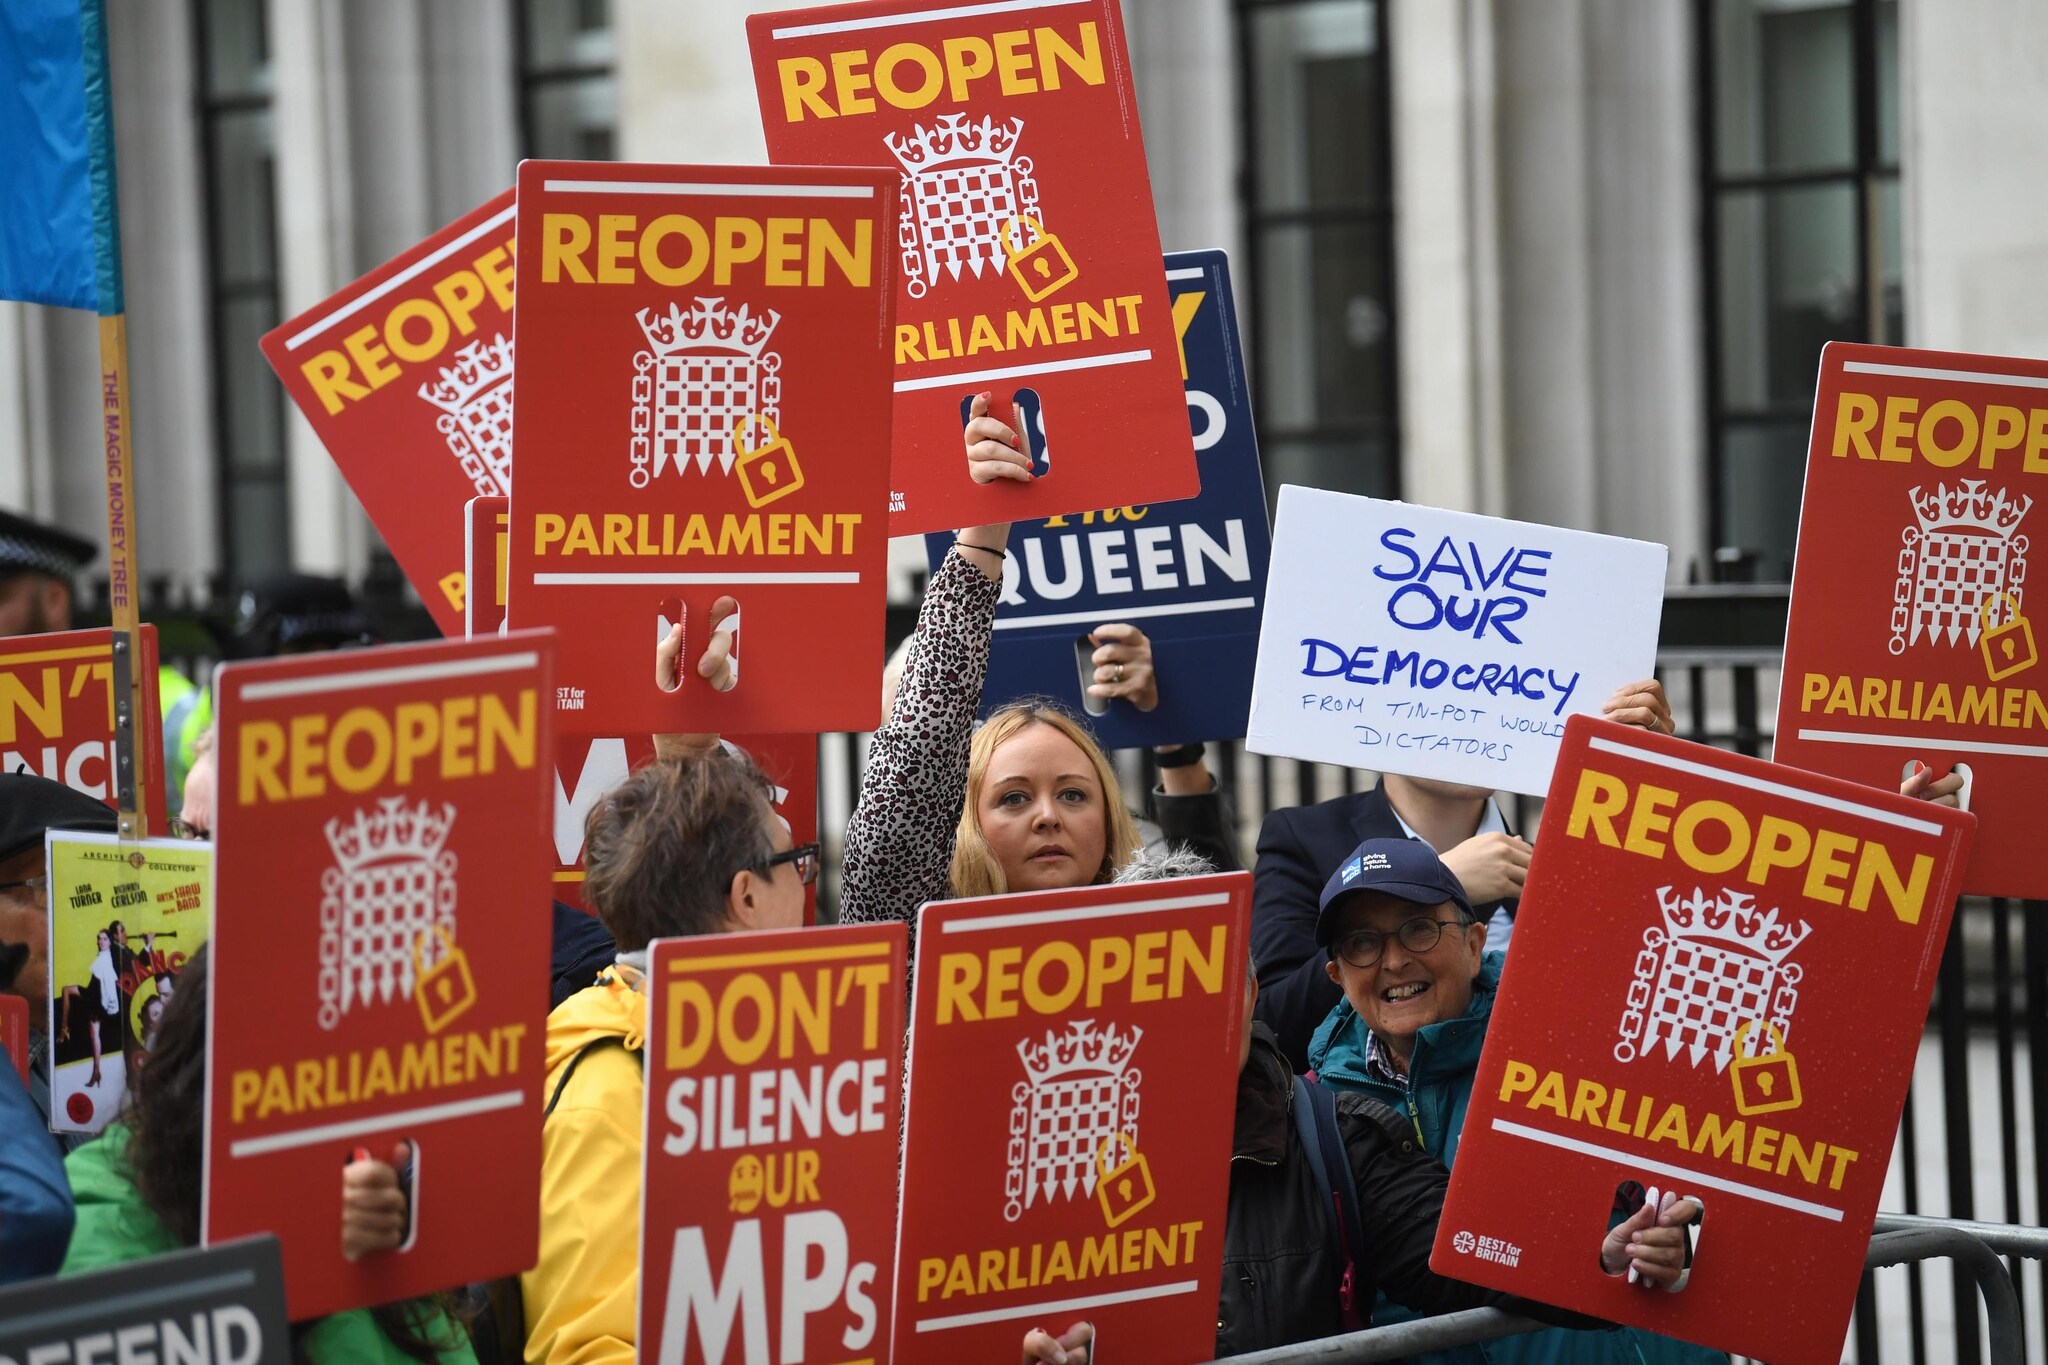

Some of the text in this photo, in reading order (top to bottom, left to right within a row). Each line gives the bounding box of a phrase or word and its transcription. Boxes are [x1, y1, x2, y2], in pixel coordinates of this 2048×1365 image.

[777, 21, 1106, 122] REOPEN
[542, 213, 873, 287] REOPEN
[300, 236, 515, 416] REOPE
[894, 295, 1143, 364] RLIAMENT
[1832, 392, 2048, 475] REOPE
[103, 371, 128, 608] THE MAGIC MONEY TREE
[534, 514, 862, 555] PARLIAMENT
[1372, 527, 1553, 598] SAVE
[1387, 582, 1529, 645] OUR
[556, 686, 585, 699] ST for
[556, 698, 584, 710] ITAIN
[1300, 638, 1580, 716] DEMOCRACY
[1801, 673, 2048, 730] PARLIAMEN
[238, 689, 538, 806] REOPEN
[1301, 694, 1566, 738] FROM TIN-POT WOULD
[1353, 725, 1514, 762] DICTATORS
[82, 851, 196, 873] ARCHIVE COLLECTION
[1363, 853, 1387, 862] giving
[1566, 768, 1935, 925] REOPEN
[69, 891, 102, 909] TURNER
[75, 883, 93, 895] LANA
[111, 890, 148, 909] CARLSON
[174, 882, 201, 900] SHAW
[176, 896, 201, 912] BAND
[117, 949, 189, 997] DANC
[936, 925, 1227, 1026] REOPEN
[666, 963, 890, 1070] DON'T
[231, 1024, 527, 1124] PARLIAMENT
[663, 1058, 888, 1157] SILENCE
[1499, 1060, 1859, 1191] PARLIAMENT
[918, 1221, 1203, 1303] PARLIAMENT
[1474, 1246, 1519, 1268] BRITAIN
[1478, 1235, 1522, 1256] BEST for
[657, 1209, 878, 1365] MPs
[0, 1304, 262, 1365] FEND
